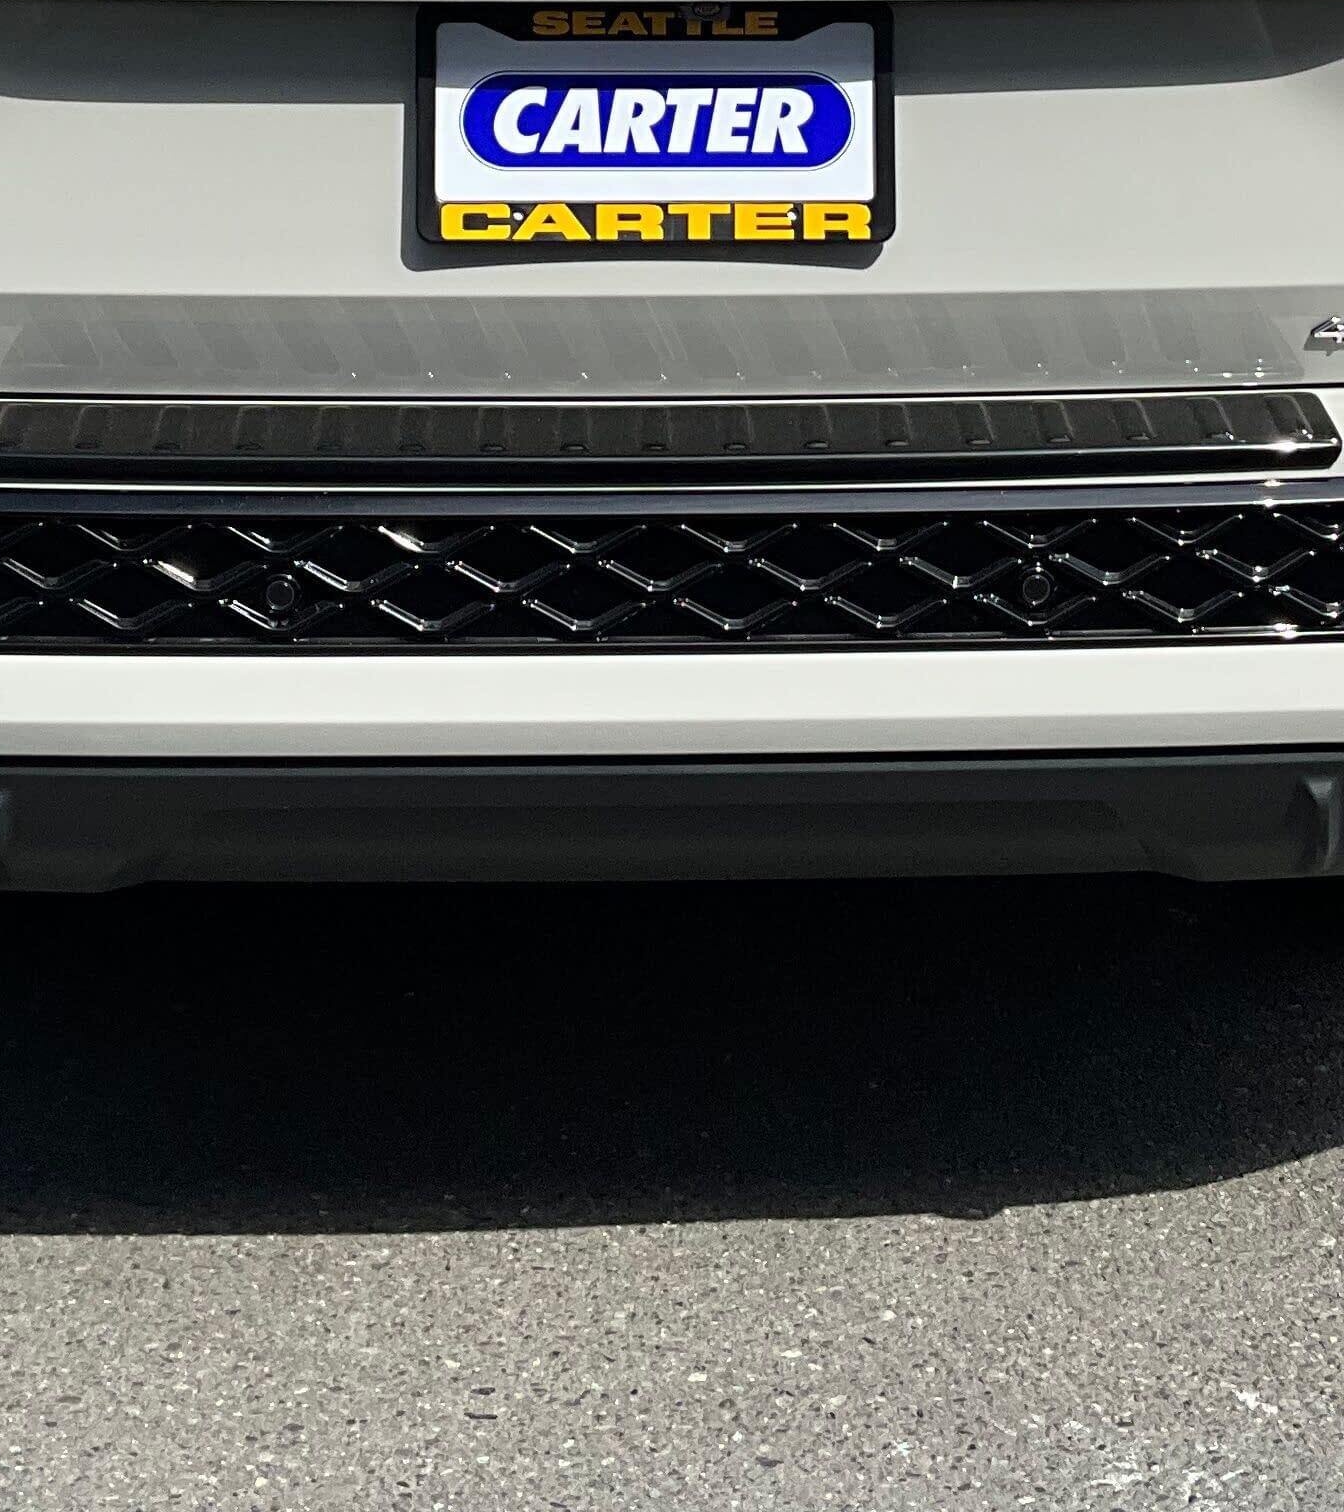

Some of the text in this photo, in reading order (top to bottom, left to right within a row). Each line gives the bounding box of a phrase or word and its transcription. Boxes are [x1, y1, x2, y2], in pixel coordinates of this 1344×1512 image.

[532, 10, 779, 36] SEATTLE
[493, 87, 814, 154] CARTER
[440, 202, 872, 240] CARTER
